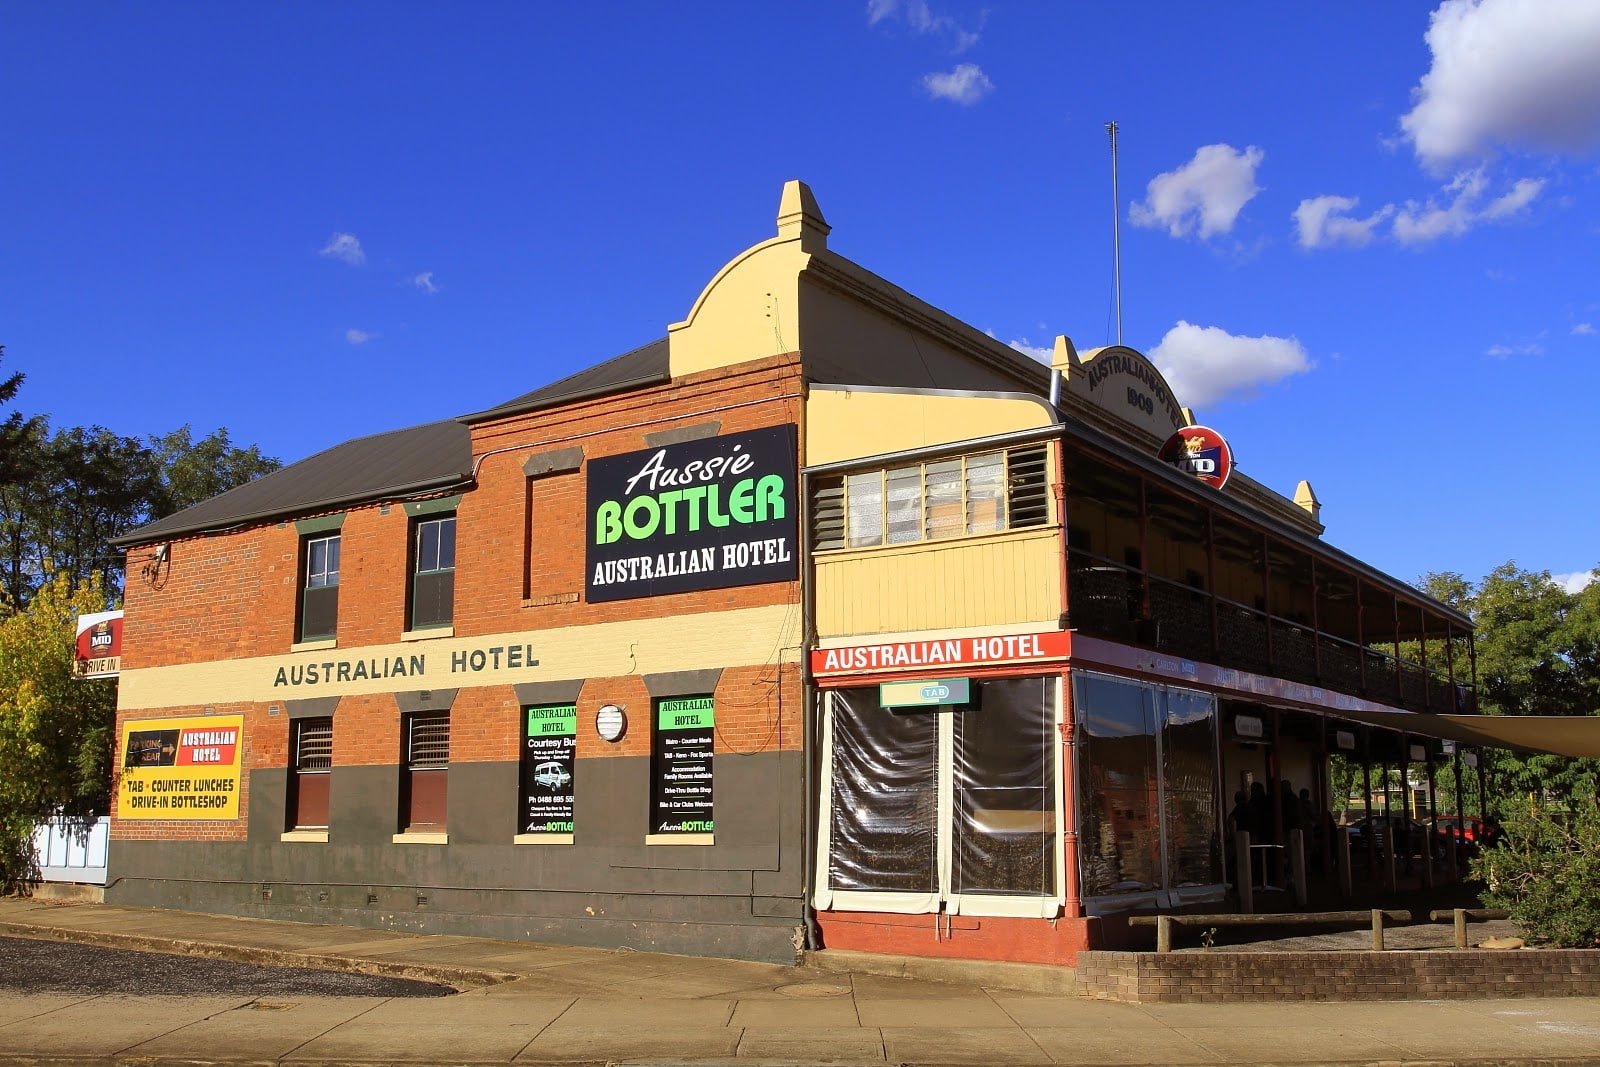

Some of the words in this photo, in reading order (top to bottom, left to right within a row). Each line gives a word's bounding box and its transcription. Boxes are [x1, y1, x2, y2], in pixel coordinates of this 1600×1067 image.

[1089, 356, 1154, 391] AUSTRALIAN
[1127, 387, 1153, 415] 1909
[625, 444, 754, 495] Aussie
[596, 474, 785, 544] BOTTLER
[592, 547, 716, 586] AUSTRALIAN
[722, 538, 790, 570] HOTEL
[92, 635, 112, 646] MID
[824, 640, 961, 670] AUSTRALIAN
[973, 635, 1044, 660] HOTEL
[108, 658, 116, 670] IN
[274, 654, 425, 687] AUSTRALIAN
[452, 644, 540, 673] HOTEL
[924, 688, 945, 697] TAB
[662, 700, 714, 712] AUSTRALIAN
[532, 708, 576, 719] AUSTRALIAN
[674, 715, 701, 726] HOTEL
[542, 723, 566, 732] HOTEL
[182, 732, 236, 746] AUSTRALIAN
[528, 739, 562, 748] Courtesy
[192, 748, 220, 762] HOTEL
[128, 780, 144, 792] TAB
[152, 780, 190, 792] COUNTER
[194, 778, 234, 792] LUNCHES
[132, 796, 168, 808] DRIVE-IN
[172, 796, 228, 808] BOTTLESHOP
[546, 822, 574, 832] BOTTLE
